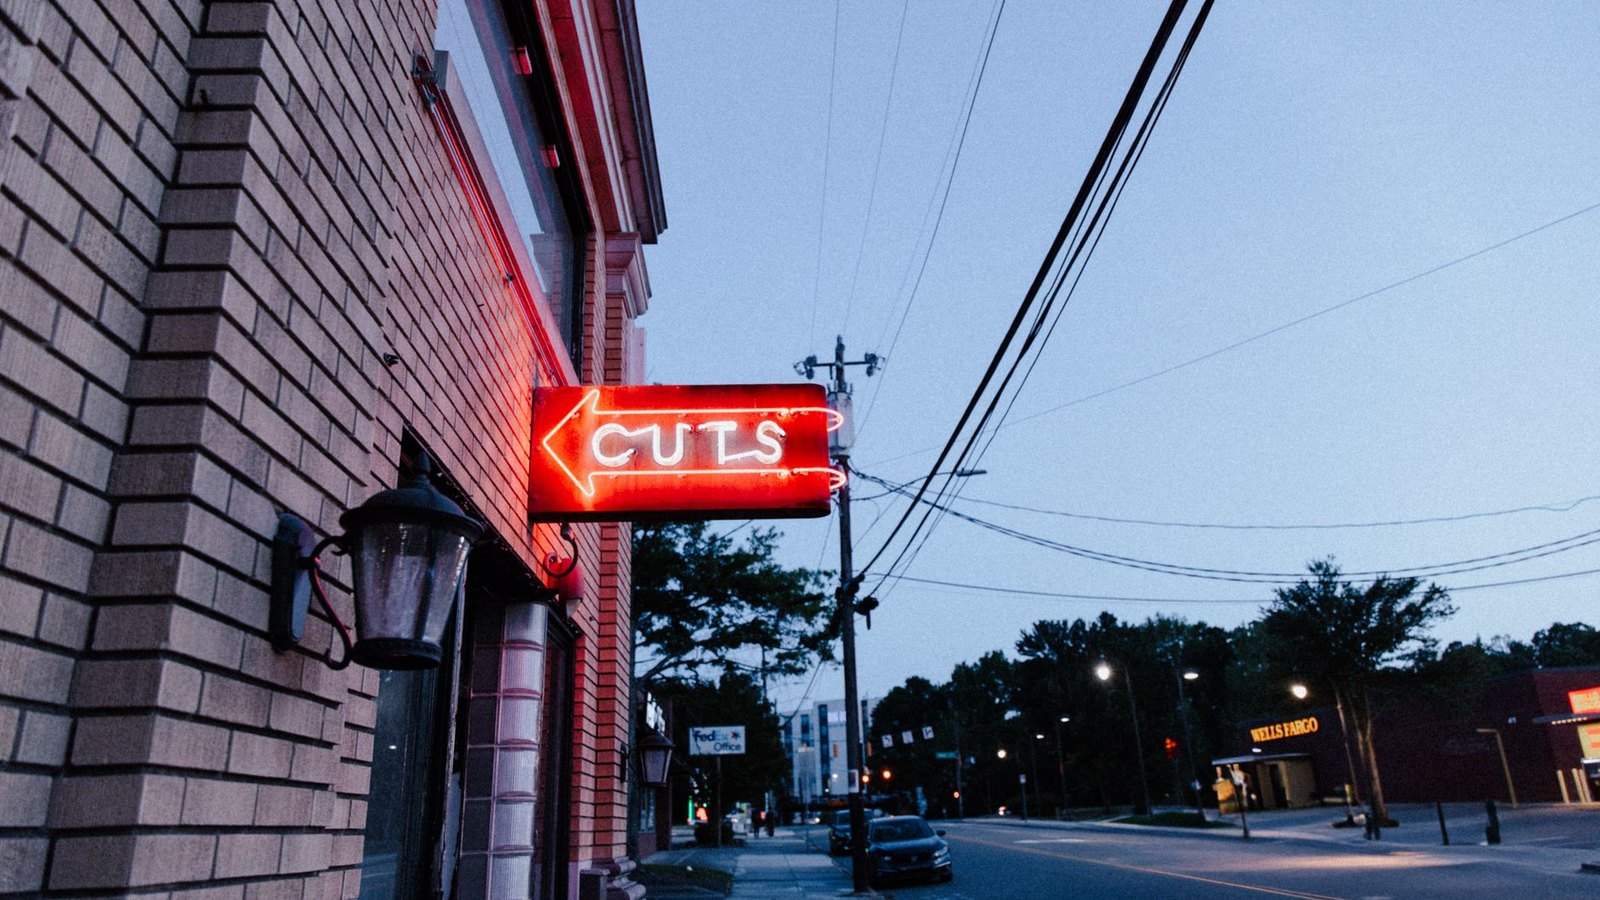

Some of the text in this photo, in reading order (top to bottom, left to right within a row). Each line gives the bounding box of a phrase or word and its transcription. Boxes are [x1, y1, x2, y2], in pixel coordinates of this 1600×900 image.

[592, 421, 786, 467] CUTS
[1250, 717, 1318, 742] WELLS FARGO
[714, 742, 741, 752] Office
